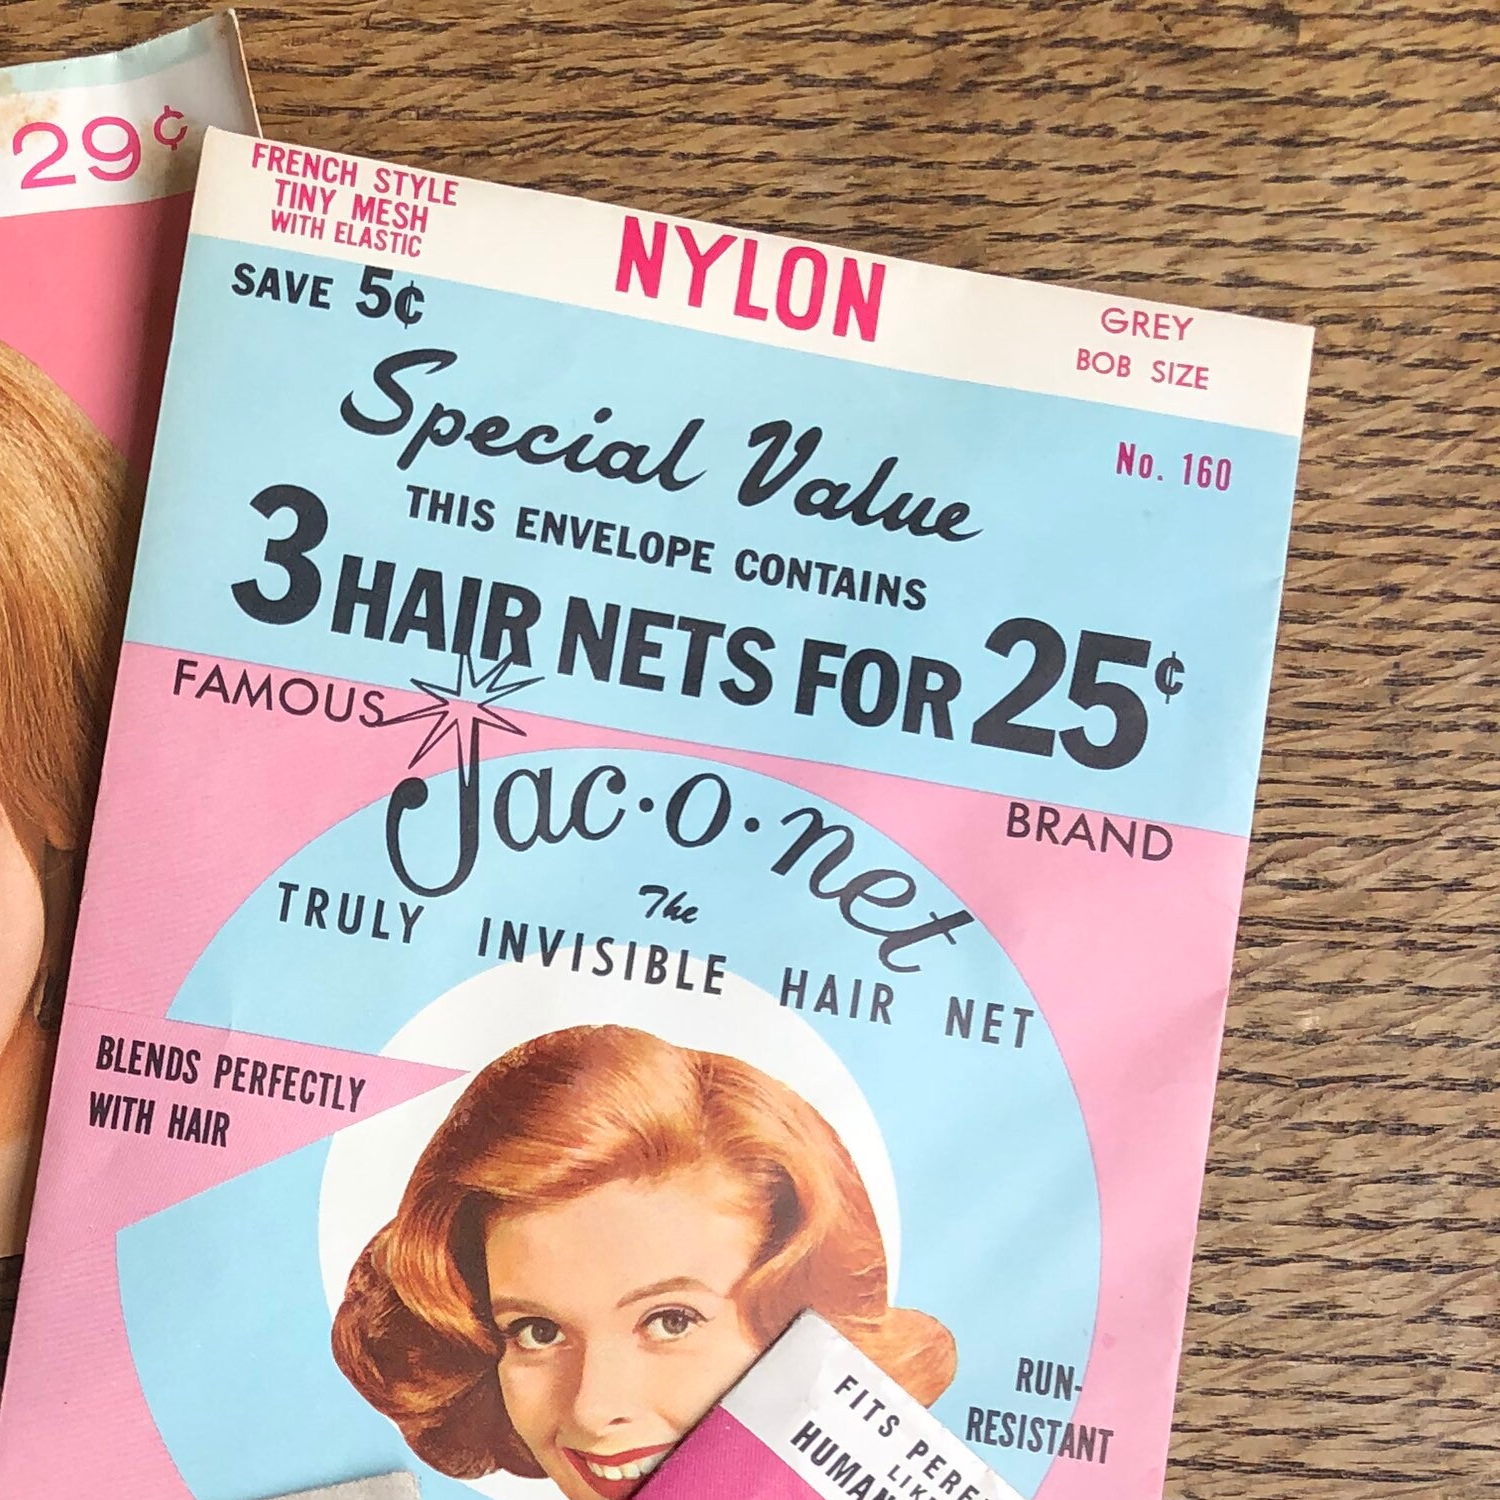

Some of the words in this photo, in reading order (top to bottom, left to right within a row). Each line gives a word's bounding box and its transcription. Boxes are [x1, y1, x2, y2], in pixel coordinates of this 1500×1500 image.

[252, 143, 358, 188] FRENCH
[373, 168, 459, 207] STYLE
[270, 208, 326, 241] WITH
[334, 221, 423, 260] ELASTIC
[274, 178, 336, 216] TINY
[352, 195, 429, 234] MESH
[231, 262, 334, 310] SAVE
[615, 215, 886, 343] NYLON
[1100, 306, 1194, 342] GREY
[1075, 347, 1132, 379] BOB
[1151, 359, 1210, 391] SIZE
[339, 347, 708, 493] Special
[735, 417, 985, 543] Value
[1115, 441, 1164, 482] No.
[1182, 452, 1233, 491] 160
[406, 484, 496, 534] THIS
[515, 508, 716, 576] ENVELOPE
[733, 547, 928, 612] CONTAINS
[230, 484, 329, 626] 3
[330, 553, 542, 668] HAIR
[556, 595, 775, 707] NETS
[794, 636, 962, 742] FOR
[172, 658, 385, 728] FAMOUS
[1006, 801, 1175, 863] BRAND
[637, 884, 699, 925] The
[277, 882, 426, 945] TRULY
[477, 917, 727, 996] INVISIBLE
[779, 966, 896, 1025] HAIR
[944, 995, 1035, 1049] NET
[95, 1034, 201, 1085] BLENDS
[213, 1053, 367, 1114] PERFECTLY
[88, 1090, 156, 1135] WITH
[166, 1104, 232, 1149] HAIR
[834, 1375, 901, 1441] FITS
[1015, 1357, 1084, 1400] RUN-
[965, 1406, 1115, 1466] RESISTANT
